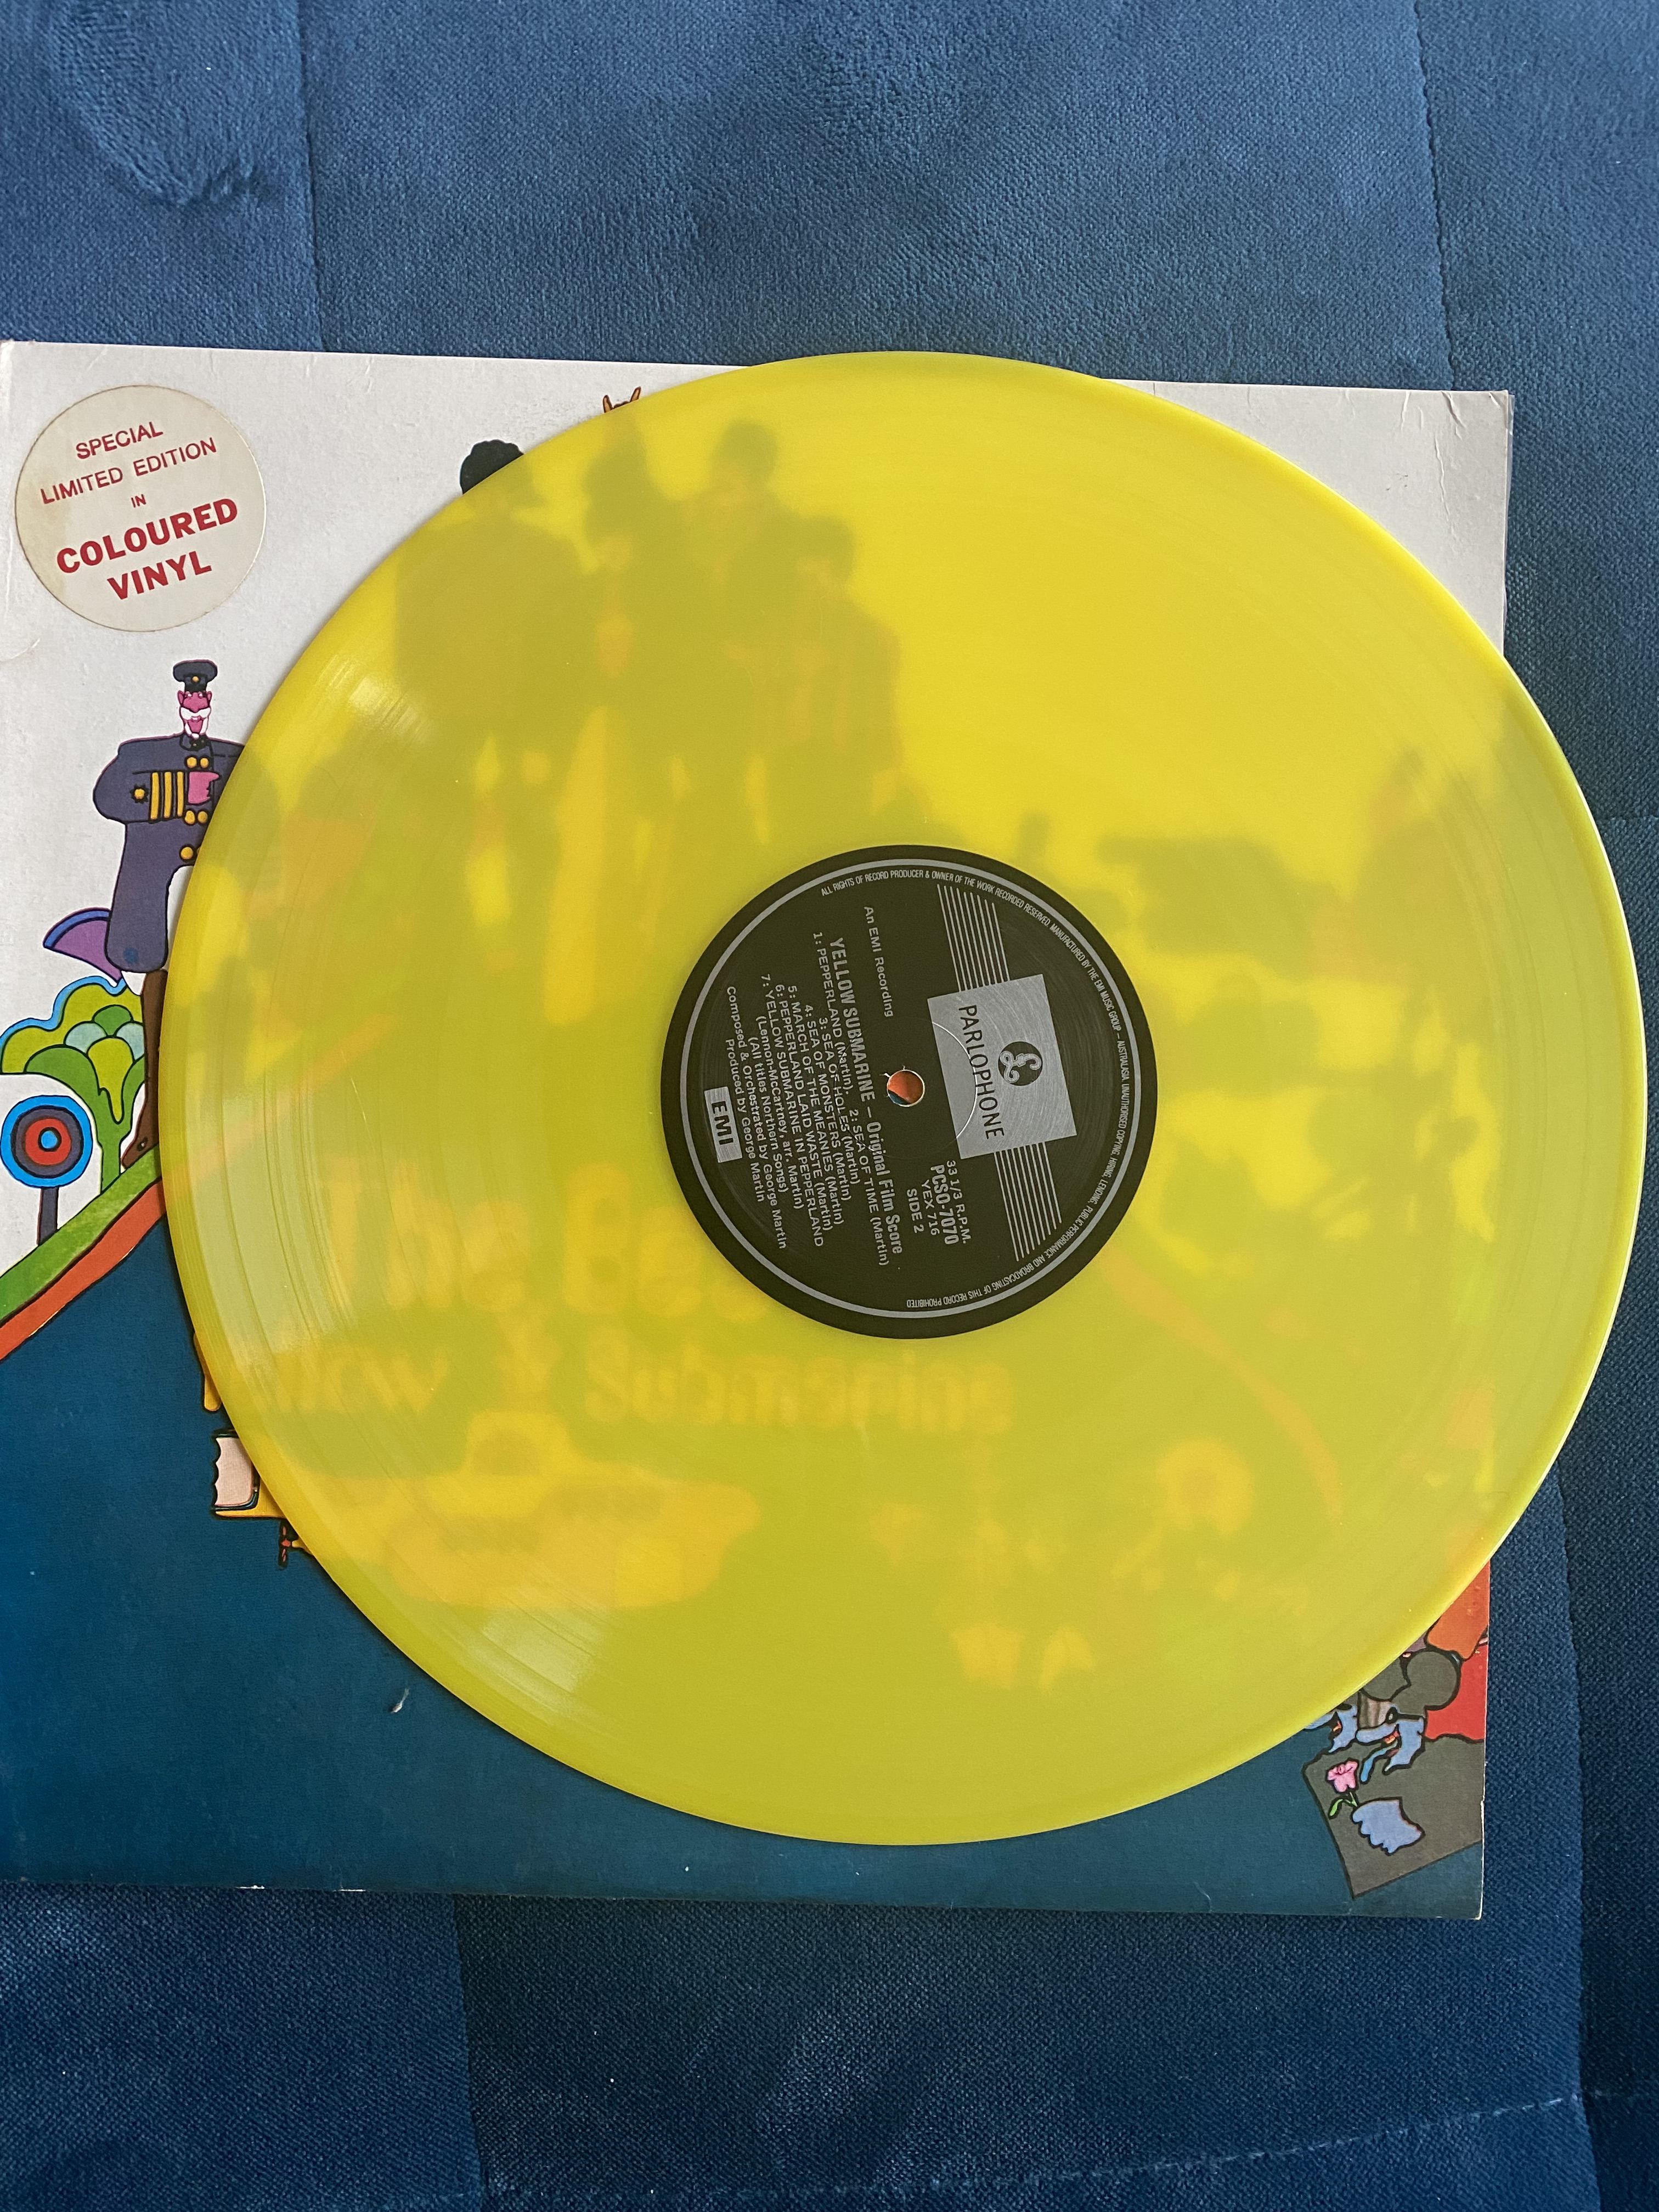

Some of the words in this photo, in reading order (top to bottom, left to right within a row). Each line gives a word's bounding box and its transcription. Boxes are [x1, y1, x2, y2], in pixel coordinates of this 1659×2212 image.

[76, 421, 163, 459] SPECIAL
[41, 467, 123, 505] LIMITED
[133, 437, 217, 476] EDITION
[131, 494, 146, 508] IN
[57, 498, 238, 573] COLOURED
[107, 551, 212, 600] VINYL
[832, 877, 855, 891] RIGHTS
[855, 874, 863, 884] OF
[864, 870, 889, 882] RECORD
[890, 869, 923, 878] PRODUCER
[924, 870, 929, 878] &
[931, 870, 954, 882] OWNER
[954, 874, 963, 883] OF
[964, 876, 975, 887] THE
[976, 880, 995, 894] WORK
[821, 885, 833, 896] ALL
[994, 887, 1024, 908] RECORDED
[864, 906, 874, 923] An
[812, 932, 822, 944] 1:
[868, 927, 882, 952] EMI
[1049, 923, 1085, 961] MANUFACTURED
[830, 937, 855, 1003] YELLOW
[1081, 959, 1092, 968] BY
[1087, 967, 1099, 980] THE
[760, 973, 771, 987] 7:
[775, 984, 785, 997] 6:
[787, 985, 797, 998] 5:
[816, 947, 842, 1037] PEPPERLAND
[874, 956, 893, 1017] Recording
[1093, 979, 1105, 991] EMI
[804, 1004, 813, 1017] 4:
[1099, 990, 1114, 1011] MUSIC
[726, 986, 748, 1048] Composed
[765, 989, 784, 1047] YELLOW
[791, 1001, 809, 1052] MARCH
[819, 1017, 828, 1030] 3:
[1108, 1011, 1121, 1031] GROUP
[747, 1036, 762, 1059] (All
[778, 1000, 804, 1090] PEPPERLAND
[806, 1020, 820, 1048] SEA
[821, 1032, 834, 1061] SEA
[725, 1039, 744, 1094] Produced
[740, 1052, 749, 1062] &
[802, 1056, 814, 1074] OF
[812, 1051, 826, 1069] OF
[834, 1041, 853, 1094] (Martin).
[843, 1007, 875, 1102] SUBMARINE
[754, 1062, 767, 1093] titles
[755, 1015, 787, 1138] (Lennon-McCartney,
[828, 1063, 840, 1082] OF
[958, 1005, 1005, 1139] PARLOPHONE
[736, 1097, 747, 1113] by
[742, 1065, 766, 1141] Orchestrated
[776, 1051, 802, 1135] SUBMARINE
[806, 1077, 820, 1107] THE
[1118, 1083, 1130, 1128] UNAUTHORISED
[710, 1100, 733, 1145] EMI
[760, 1095, 778, 1150] Northern
[797, 1093, 811, 1127] LAID
[817, 1073, 841, 1148] MONSTERS
[832, 1086, 850, 1132] HOLES
[849, 1109, 859, 1121] 2:
[741, 1116, 755, 1159] George
[758, 1144, 769, 1159] by
[782, 1141, 793, 1162] arr.
[794, 1137, 805, 1153] IN
[812, 1109, 833, 1172] MEANIES
[853, 1125, 866, 1153] SEA
[866, 1121, 890, 1176] Original
[1110, 1129, 1125, 1155] COPYING,
[805, 1130, 822, 1178] WASTE
[840, 1136, 860, 1184] (Martin)
[859, 1155, 871, 1173] OF
[946, 1160, 957, 1175] 33
[1101, 1156, 1118, 1177] HIRING,
[750, 1162, 765, 1201] Martin
[763, 1164, 777, 1206] George
[772, 1153, 789, 1192] Songs)
[787, 1164, 804, 1209] Martin)
[832, 1152, 851, 1200] (Martin)
[797, 1156, 823, 1246] PEPPERLAND
[824, 1176, 844, 1224] (Martin)
[864, 1177, 879, 1213] TIME
[878, 1178, 895, 1211] Film
[921, 1179, 934, 1209] YEX
[949, 1178, 962, 1199] 1/3
[1087, 1178, 1108, 1204] LENDING,
[814, 1182, 833, 1231] (Martin)
[906, 1188, 923, 1221] SIDE
[930, 1164, 959, 1244] PCSO-7070
[1075, 1205, 1093, 1226] PUBLIC
[771, 1209, 787, 1249] Martin
[885, 1214, 902, 1254] Score
[913, 1224, 924, 1233] 2
[927, 1212, 940, 1235] 716
[955, 1203, 971, 1244] R.P.M.
[870, 1217, 889, 1265] (Martin)
[1043, 1223, 1079, 1259] PERFORMANCE
[1032, 1254, 1045, 1267] AND
[983, 1284, 991, 1294] OF
[991, 1262, 1034, 1290] BROADCASTING
[906, 1297, 942, 1308] PROHIBITED
[943, 1292, 967, 1305] RECORD
[967, 1288, 983, 1299] THIS
